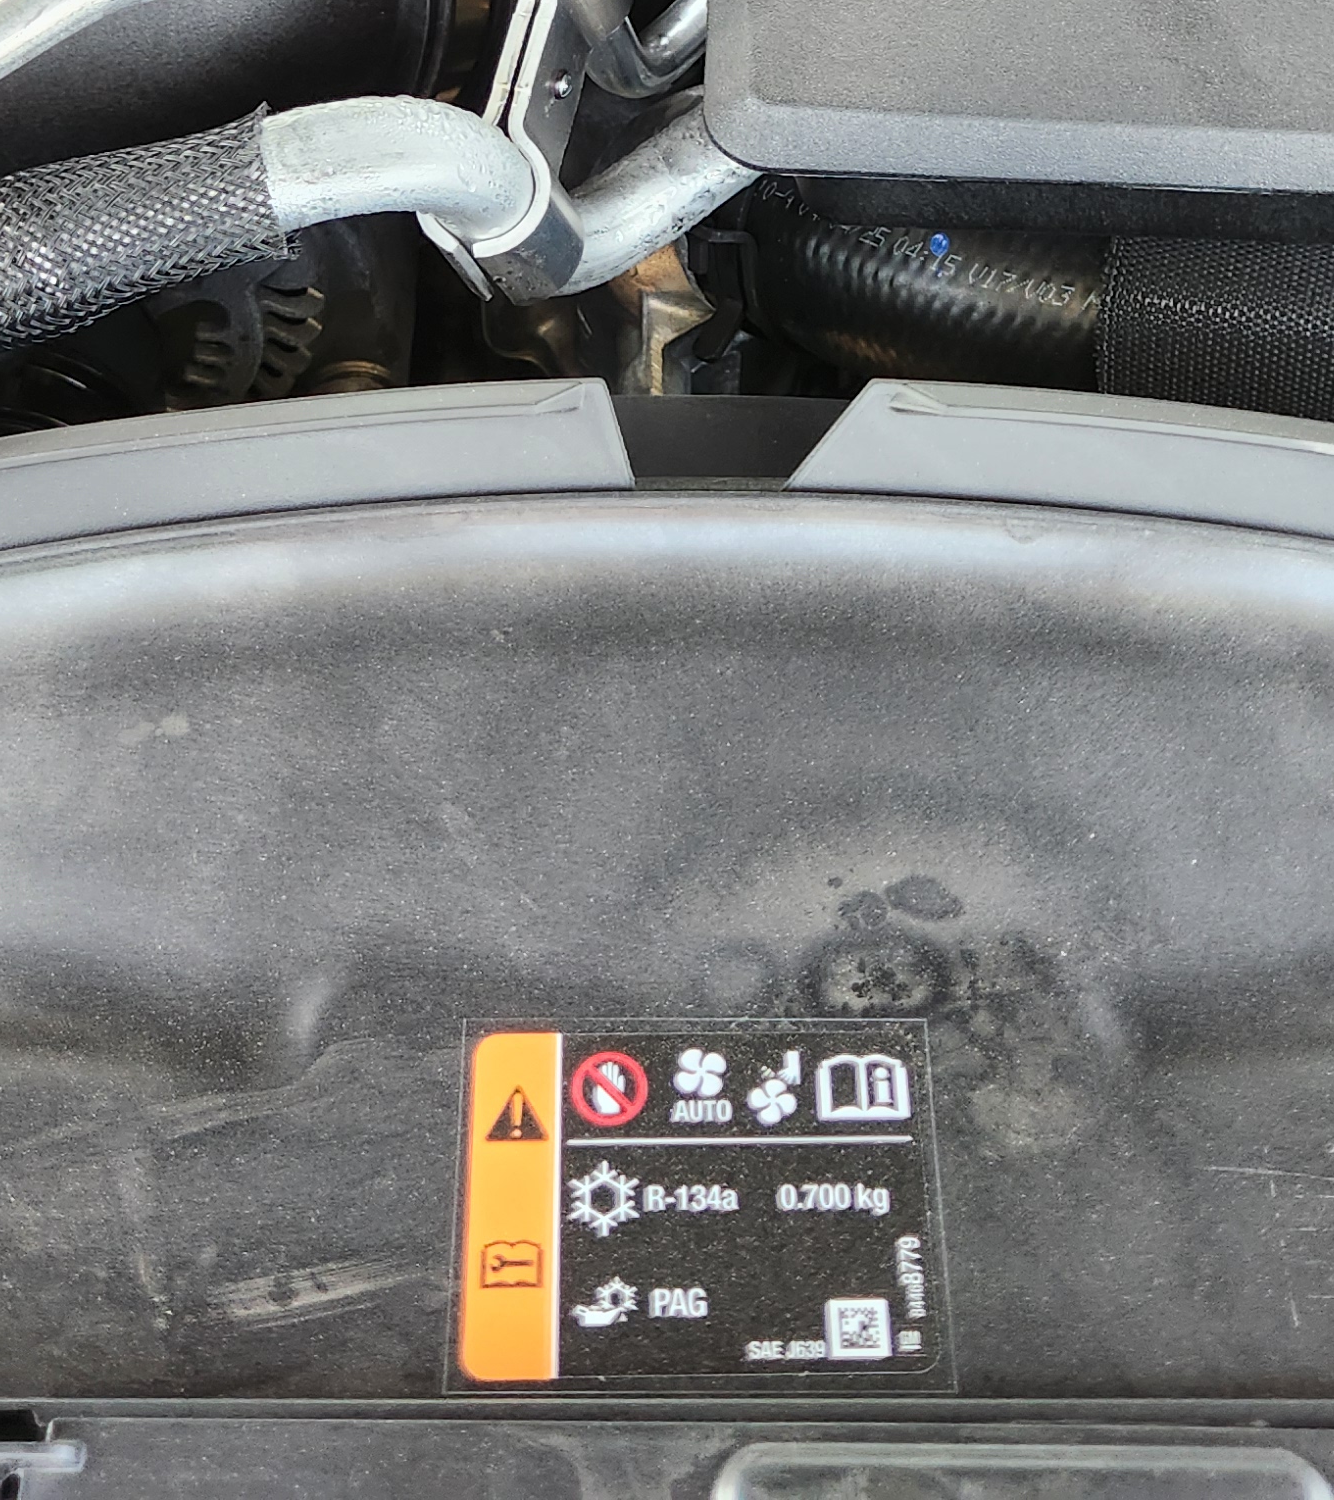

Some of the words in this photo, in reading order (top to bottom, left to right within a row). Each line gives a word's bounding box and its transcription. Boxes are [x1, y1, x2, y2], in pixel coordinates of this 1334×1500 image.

[670, 1100, 733, 1123] AUTO
[643, 1184, 741, 1212] R-134a
[775, 1183, 853, 1212] 0.700
[854, 1183, 891, 1216] kg
[649, 1288, 709, 1318] PAG
[745, 1340, 785, 1361] SAE
[784, 1340, 828, 1360] J639
